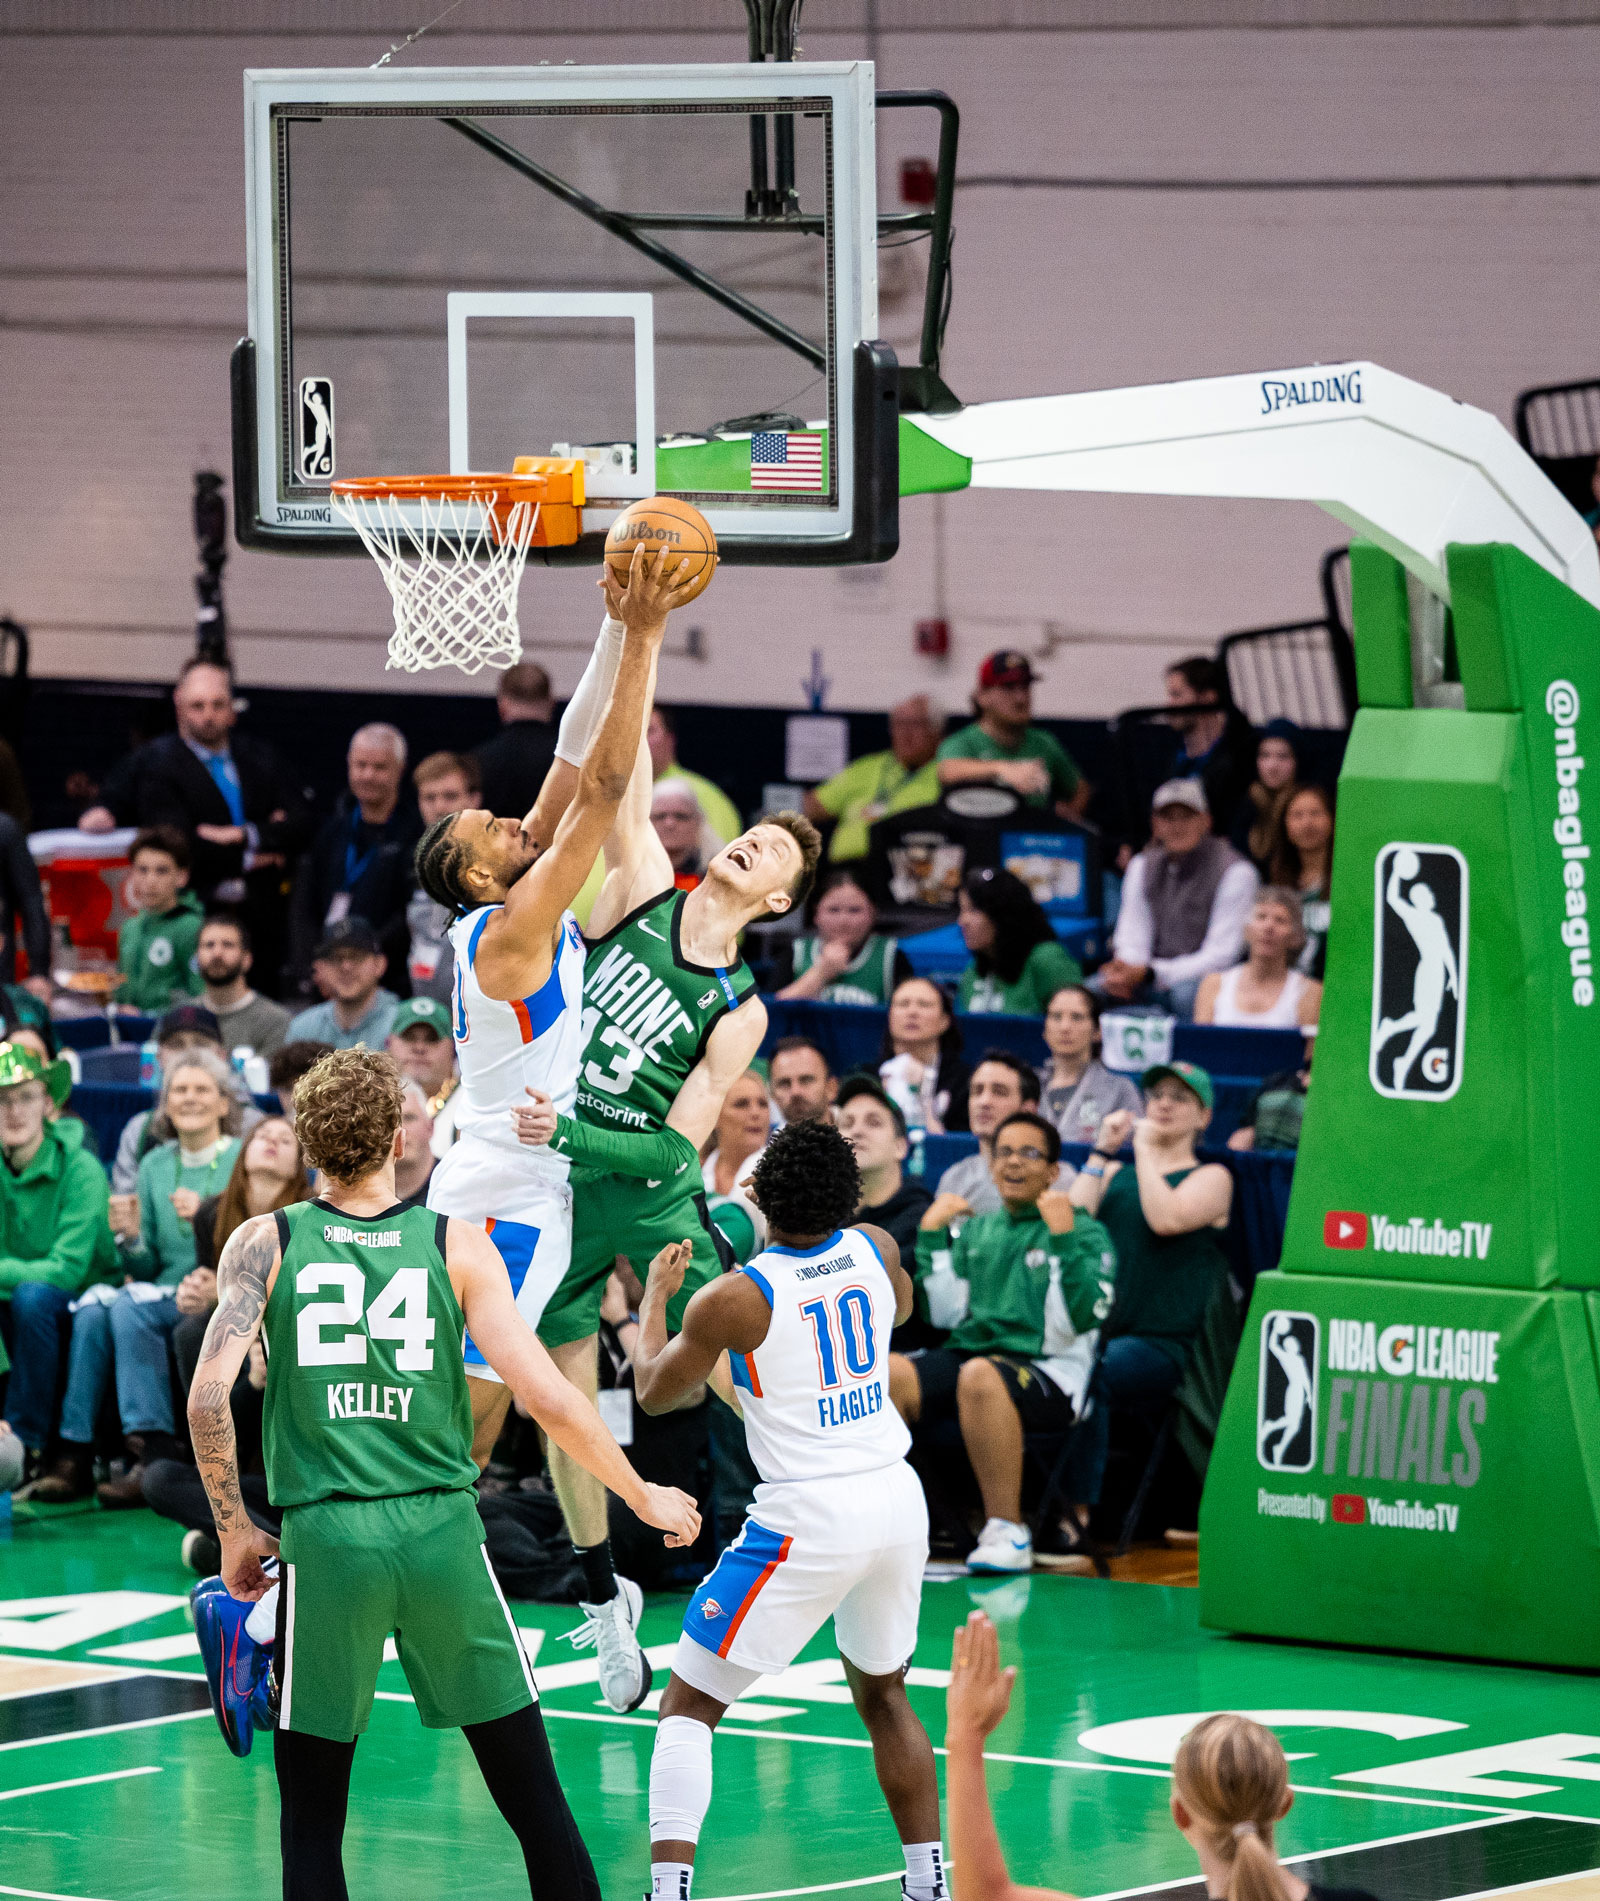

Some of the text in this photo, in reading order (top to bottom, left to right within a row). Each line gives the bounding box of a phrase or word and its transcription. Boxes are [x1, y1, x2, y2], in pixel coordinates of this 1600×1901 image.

[1262, 370, 1362, 415] SPALDING
[276, 506, 332, 523] SPALDING
[613, 520, 682, 544] Wilson
[1546, 679, 1595, 1007] @nbagleague
[583, 943, 695, 1064] MAINE
[576, 1092, 649, 1128] staprint
[296, 1263, 436, 1371] 24
[798, 1284, 878, 1391] 10
[327, 1382, 414, 1422] KELLEY
[818, 1381, 882, 1427] FLAGLER
[1323, 1377, 1487, 1488] FINALS
[1257, 1488, 1312, 1519] Presented
[1312, 1493, 1327, 1524] by
